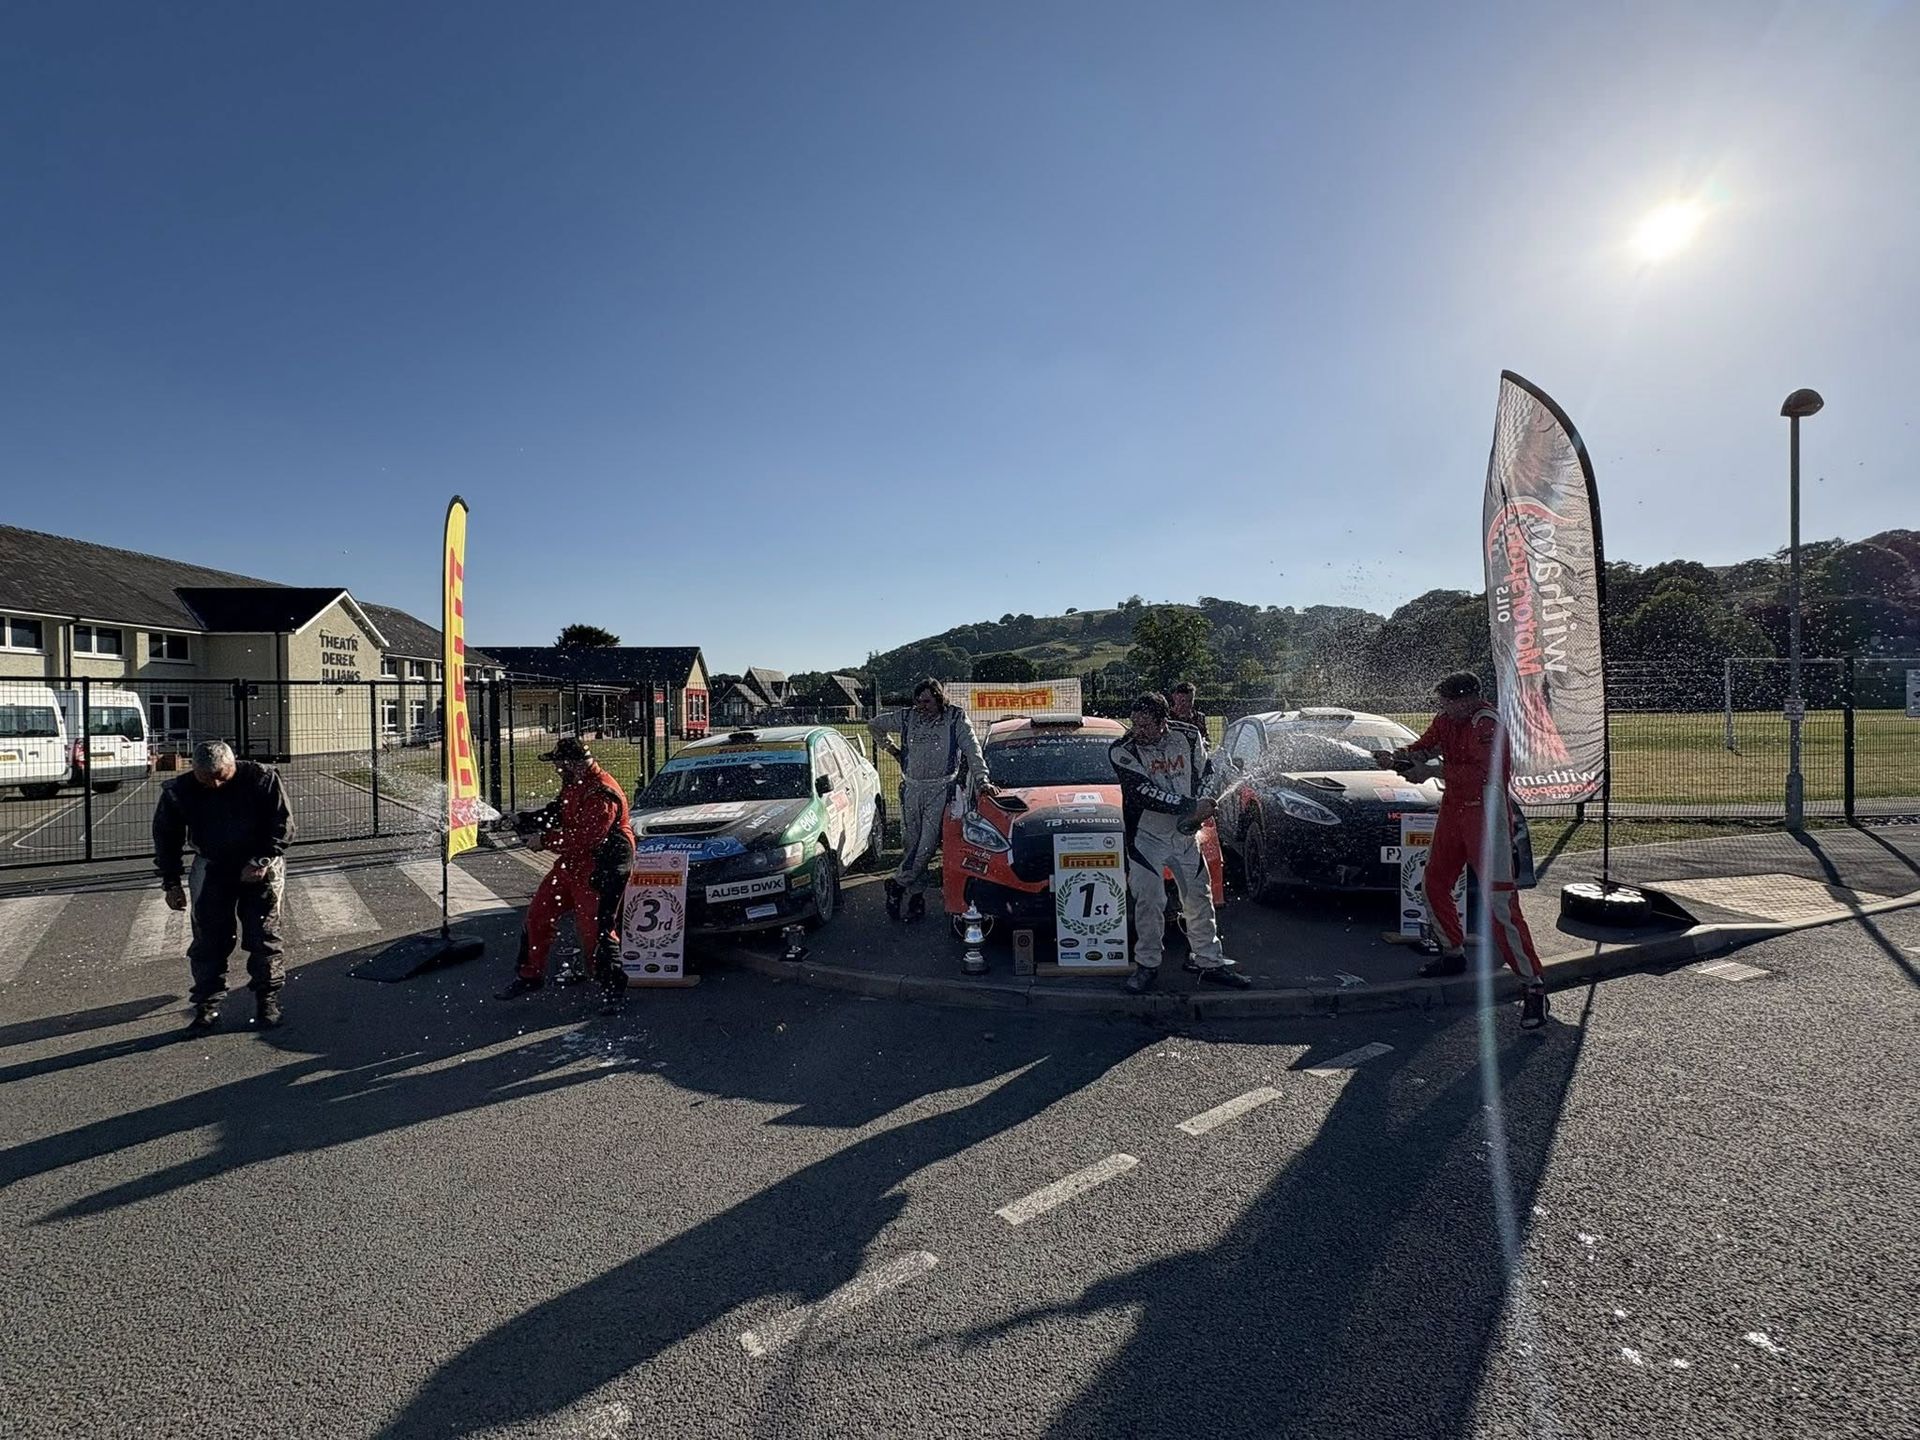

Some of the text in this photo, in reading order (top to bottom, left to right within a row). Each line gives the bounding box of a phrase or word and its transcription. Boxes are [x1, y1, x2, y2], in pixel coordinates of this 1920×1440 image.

[319, 633, 359, 652] THEATR
[321, 651, 356, 667] DEREK
[976, 690, 1048, 708] PIRELLI
[1064, 817, 1120, 825] TRADEBID
[668, 842, 703, 850] METALS
[1063, 854, 1116, 868] PIRELLI
[751, 878, 782, 893] DWX
[1079, 882, 1110, 918] 1st
[636, 899, 673, 932] 3rd
